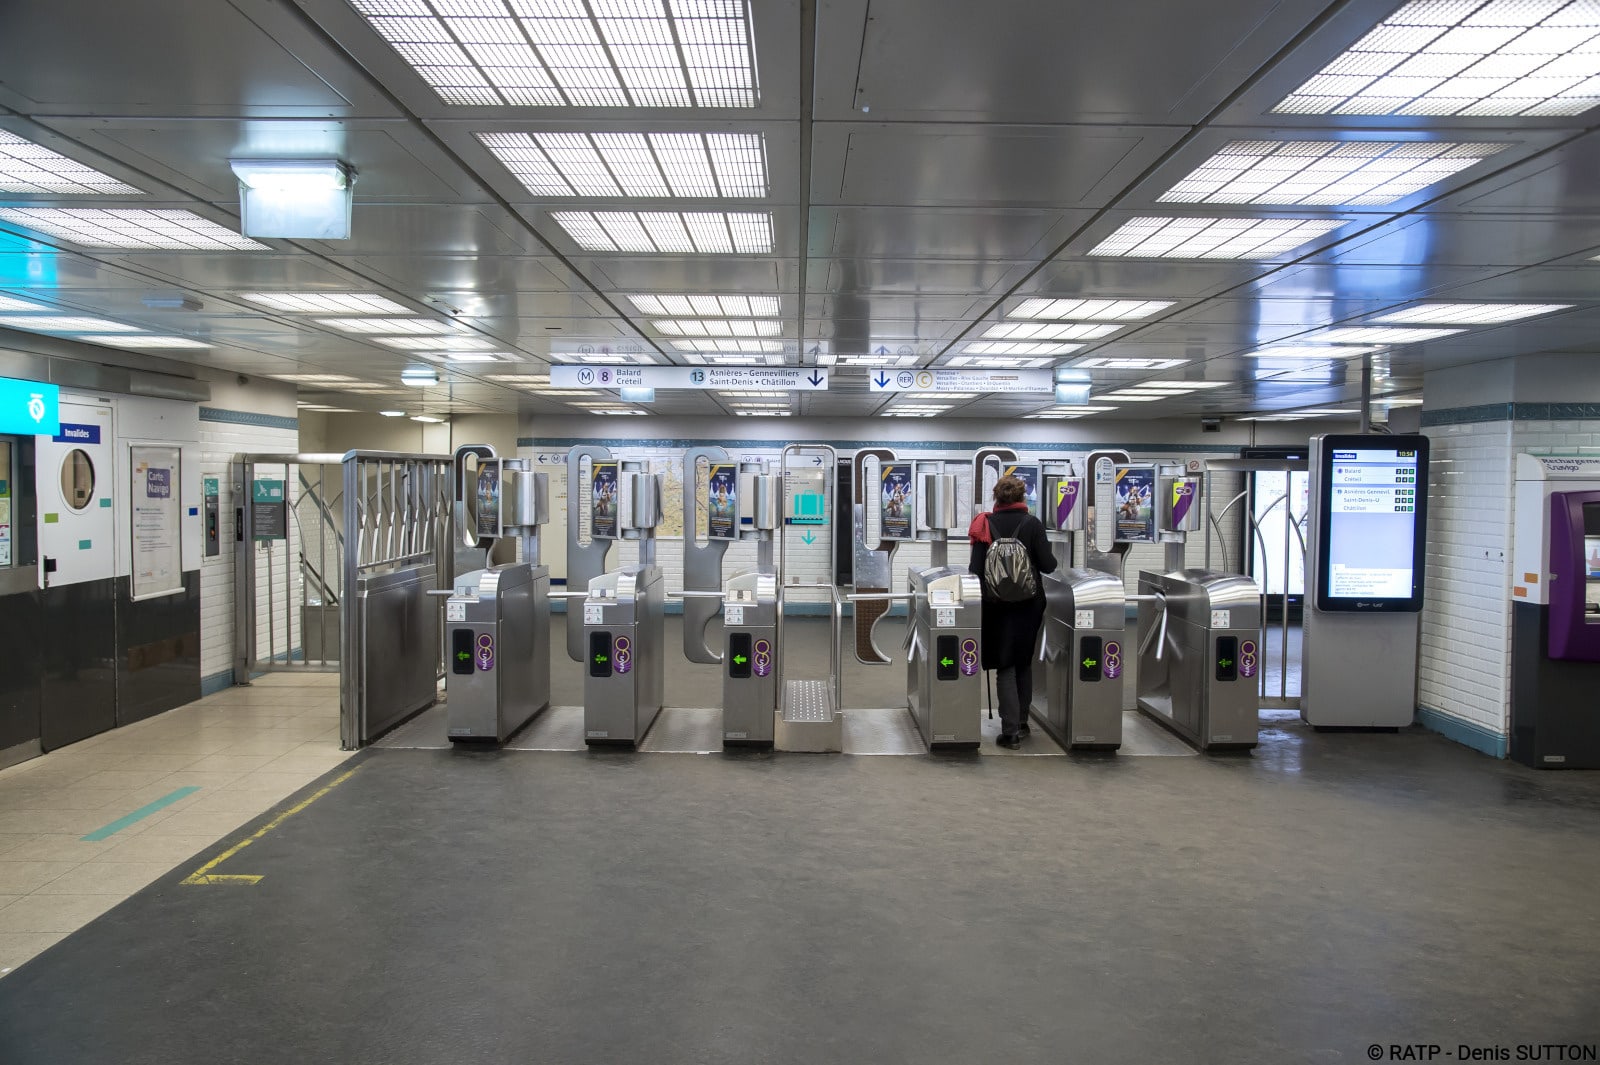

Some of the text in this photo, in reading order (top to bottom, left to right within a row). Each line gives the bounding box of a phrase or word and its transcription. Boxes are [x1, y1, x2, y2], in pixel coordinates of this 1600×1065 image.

[692, 372, 704, 382] 13
[64, 429, 90, 438] Invalides
[148, 471, 164, 482] Carte
[148, 483, 169, 496] Navigo
